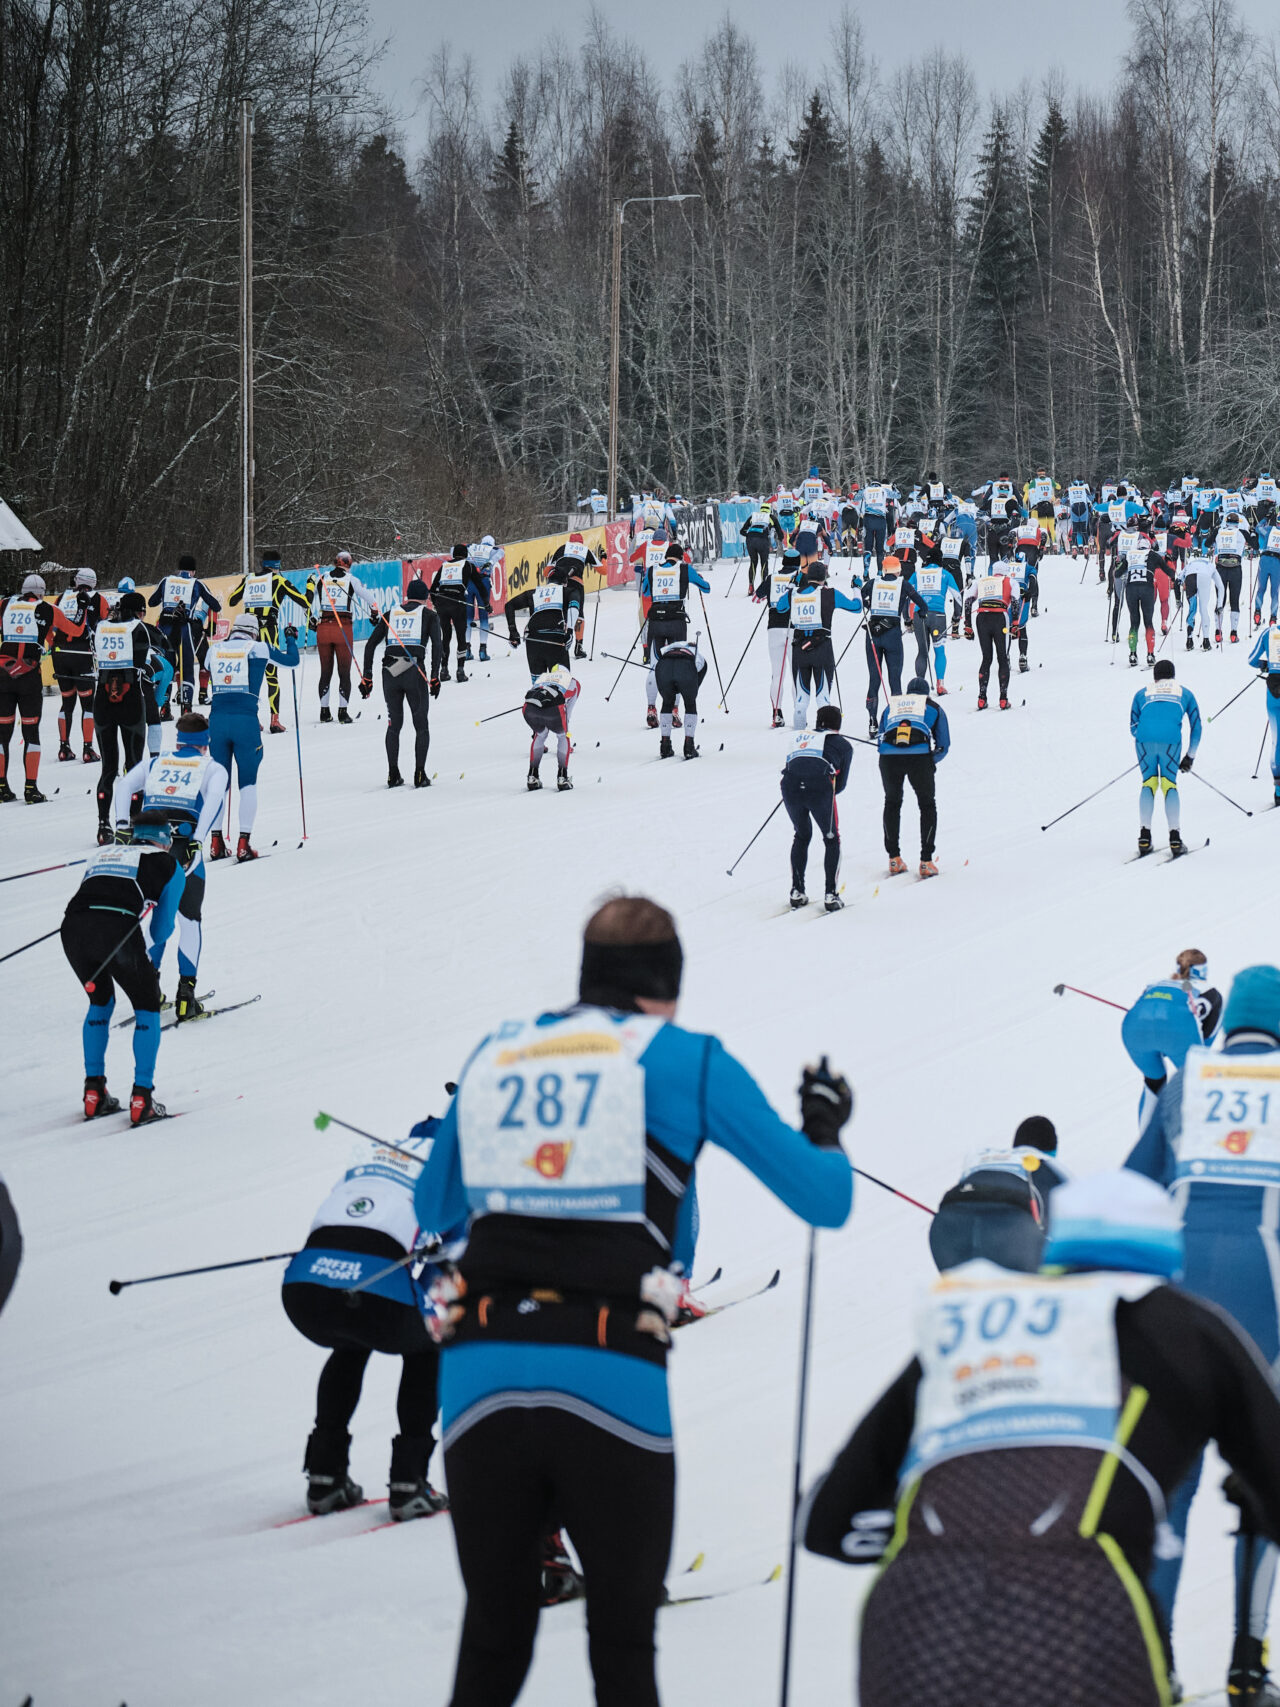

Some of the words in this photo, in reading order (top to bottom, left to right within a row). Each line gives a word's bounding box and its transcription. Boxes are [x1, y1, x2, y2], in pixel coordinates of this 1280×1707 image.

[509, 557, 530, 595] TOKO
[658, 578, 673, 587] 202
[170, 586, 186, 595] 281
[249, 584, 265, 594] 200
[326, 587, 342, 597] 252
[877, 592, 894, 601] 174
[64, 600, 75, 609] 32
[797, 605, 815, 615] 160
[10, 613, 31, 625] 226
[395, 618, 414, 629] 197
[102, 637, 124, 649] 255
[217, 662, 242, 675] 264
[158, 770, 192, 785] 234
[498, 1072, 601, 1130] 287
[1205, 1090, 1270, 1124] 231
